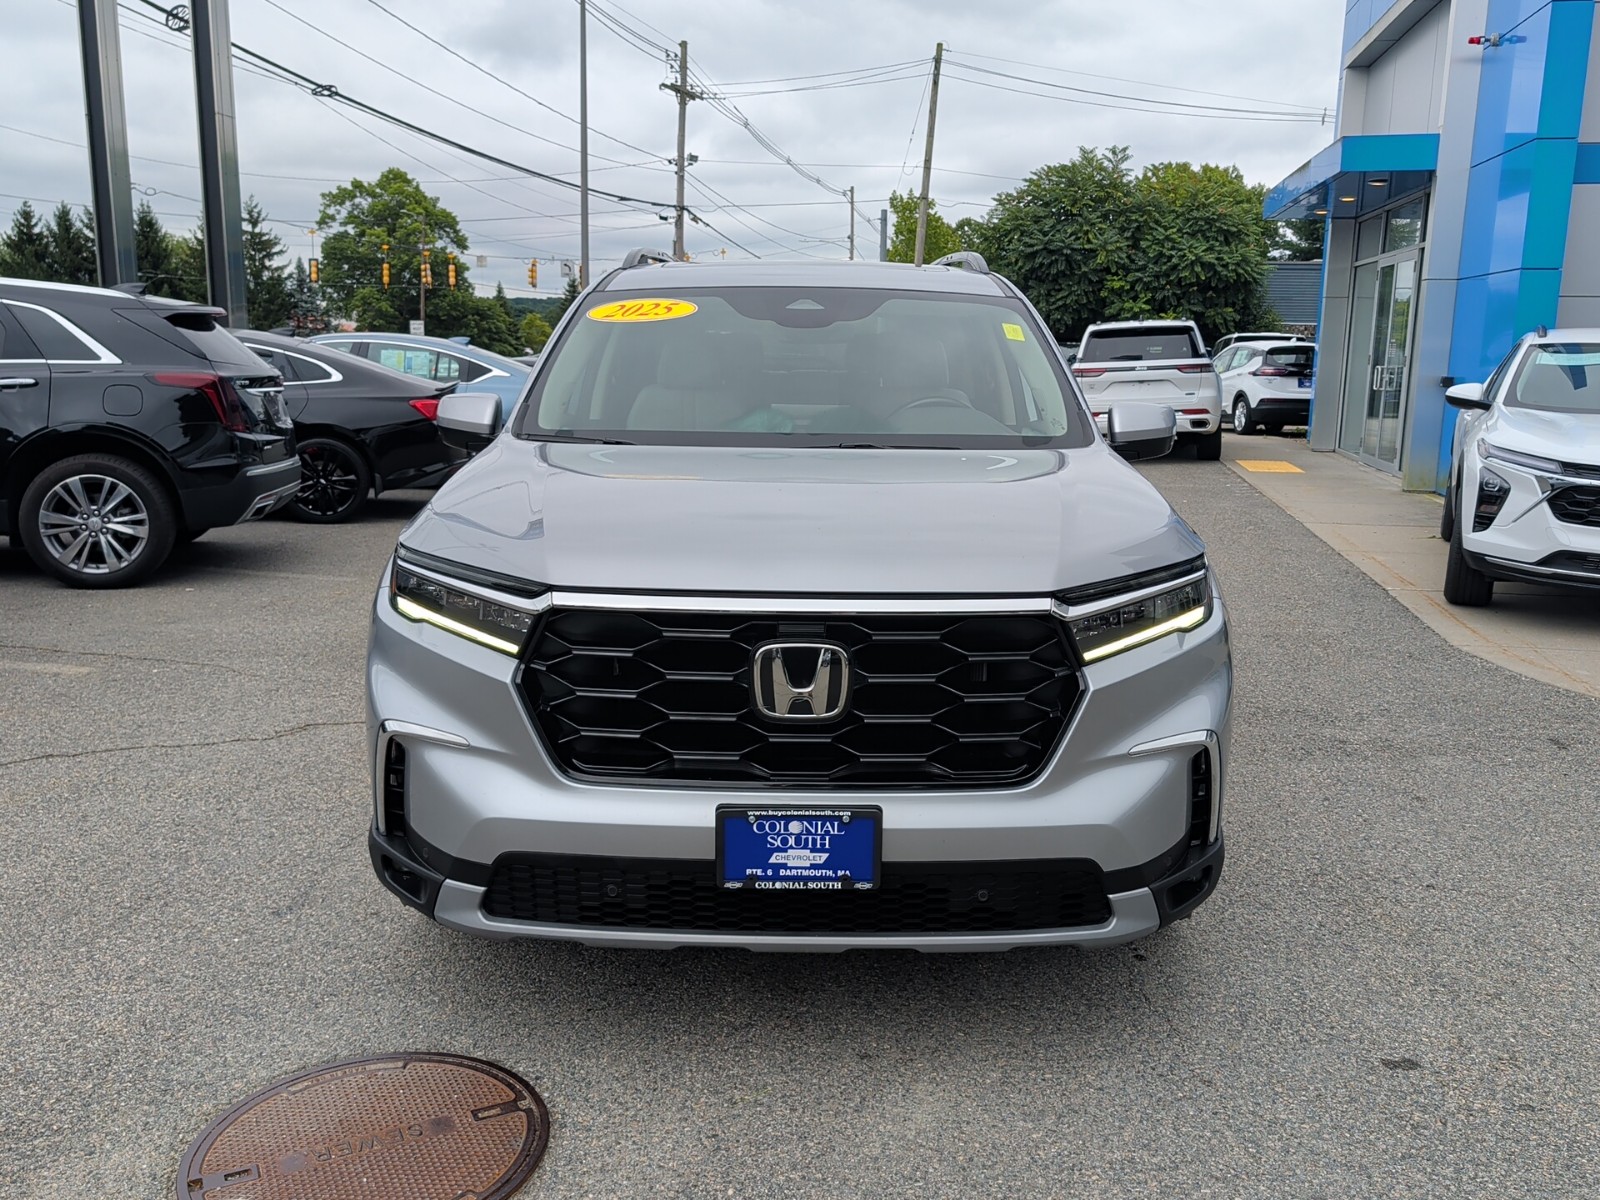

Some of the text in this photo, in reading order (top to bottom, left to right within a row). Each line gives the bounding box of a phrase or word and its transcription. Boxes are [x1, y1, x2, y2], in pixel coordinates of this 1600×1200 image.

[601, 303, 680, 318] 2025
[753, 820, 845, 834] COLONIAL
[767, 835, 830, 848] SOUTH
[775, 854, 823, 862] CHEVROLET
[746, 868, 765, 876] RTE.
[780, 869, 836, 877] DARTMOUTH,
[310, 1123, 423, 1162] SEWER
